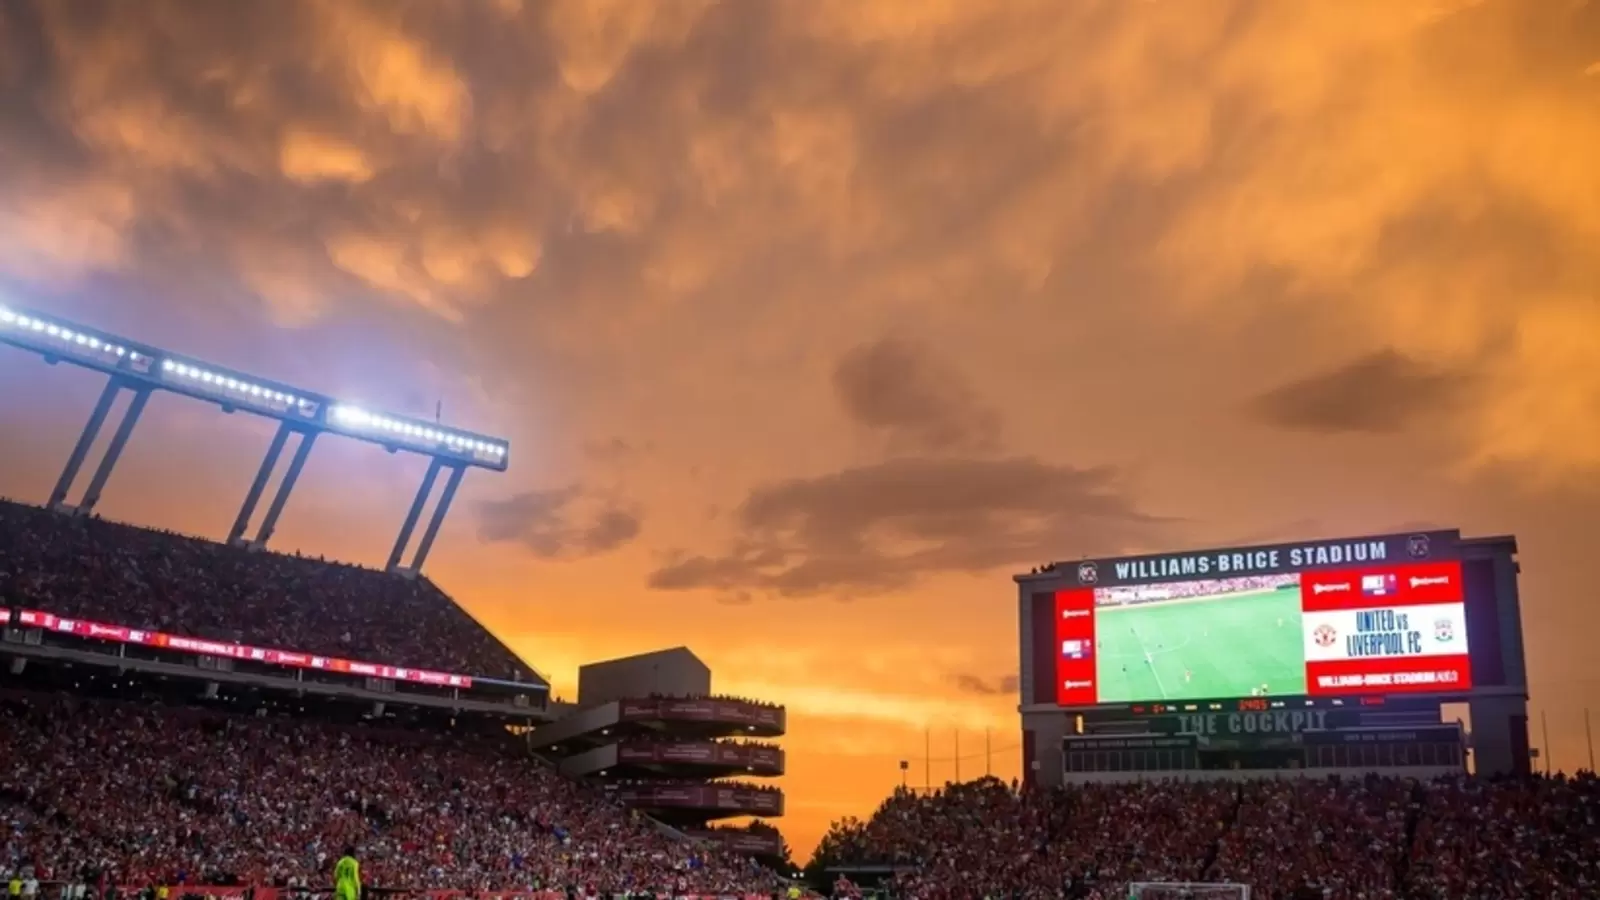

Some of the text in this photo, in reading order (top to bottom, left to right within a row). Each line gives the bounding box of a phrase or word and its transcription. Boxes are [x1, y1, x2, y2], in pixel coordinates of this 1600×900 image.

[1115, 541, 1386, 580] WILLIAMS-BRICE STADIUM
[1356, 610, 1394, 632] UNITED
[1346, 631, 1422, 657] LIVERPOOL FC
[1179, 710, 1327, 733] THE COCKPIT
